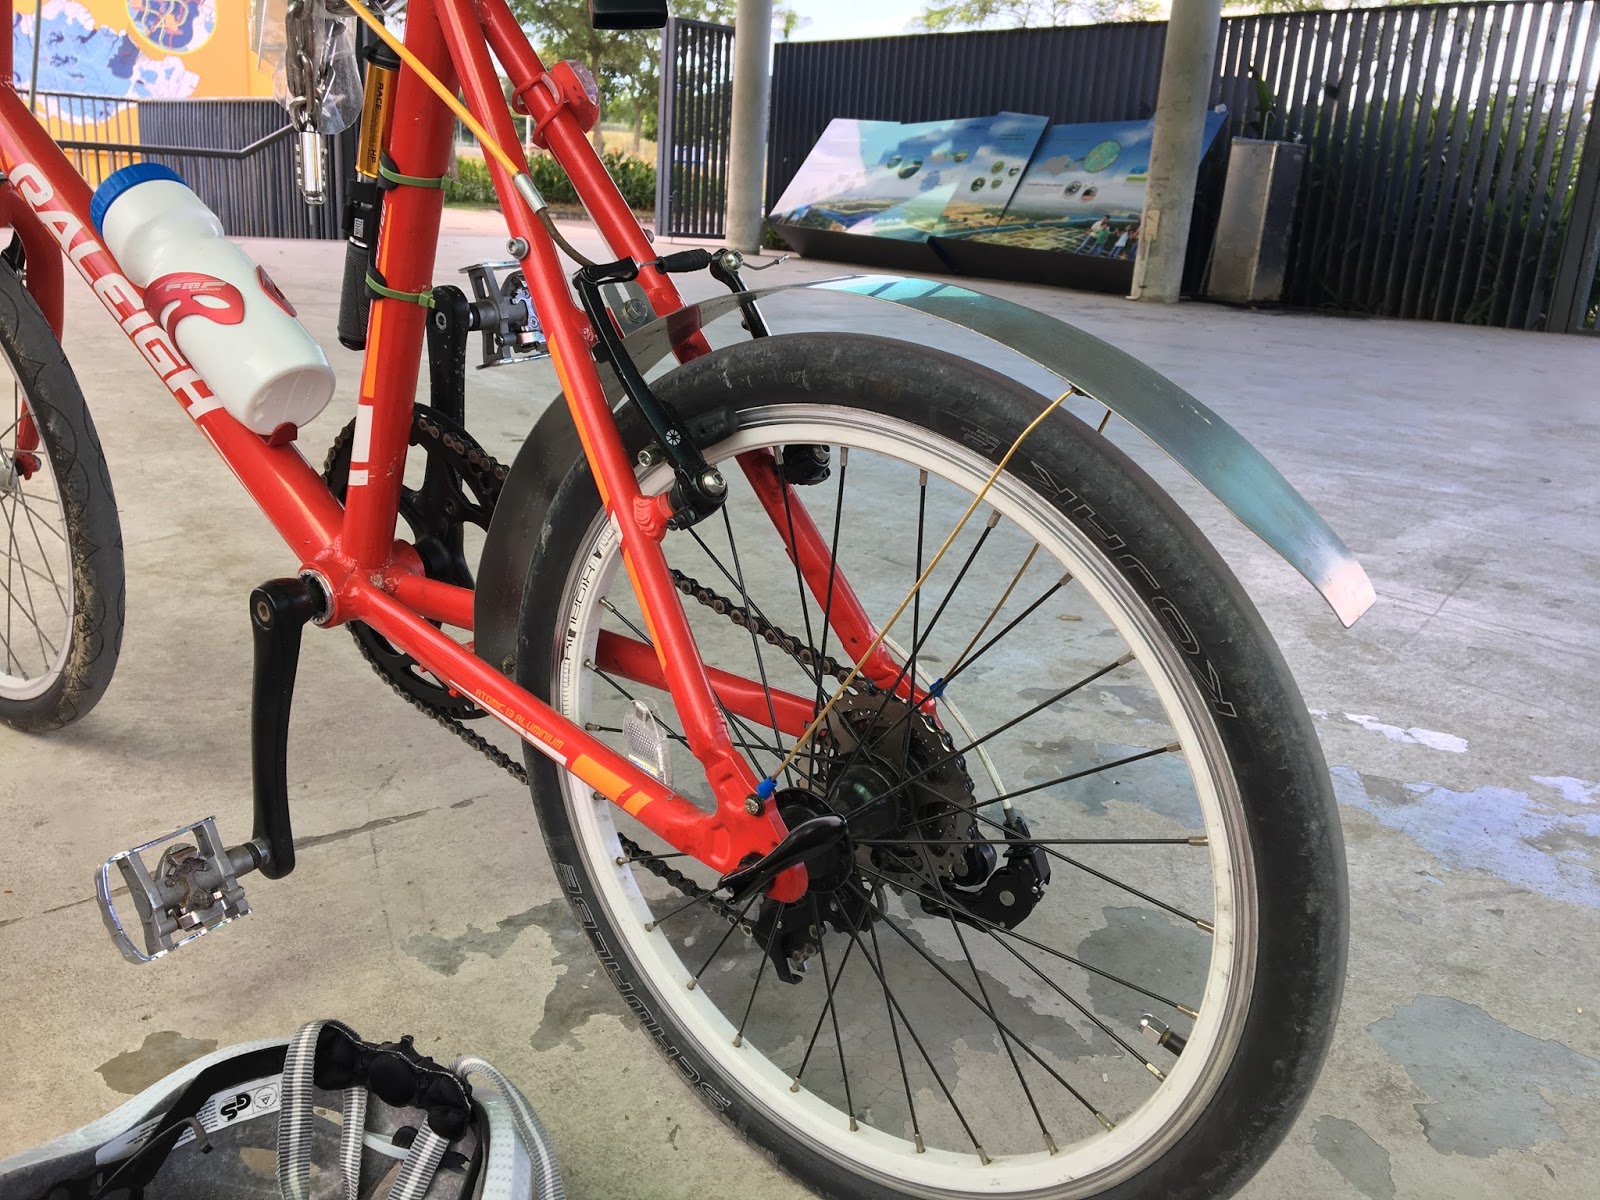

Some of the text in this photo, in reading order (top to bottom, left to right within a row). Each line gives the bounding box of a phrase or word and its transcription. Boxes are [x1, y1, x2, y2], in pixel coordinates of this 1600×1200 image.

[370, 149, 377, 164] HP
[375, 82, 384, 111] RACE
[8, 162, 224, 419] RALEIGH
[1021, 460, 1238, 718] KOJAK
[475, 688, 565, 750] ATOMIC 13 ALUMINIUM
[558, 862, 732, 1113] SCHWALBE
